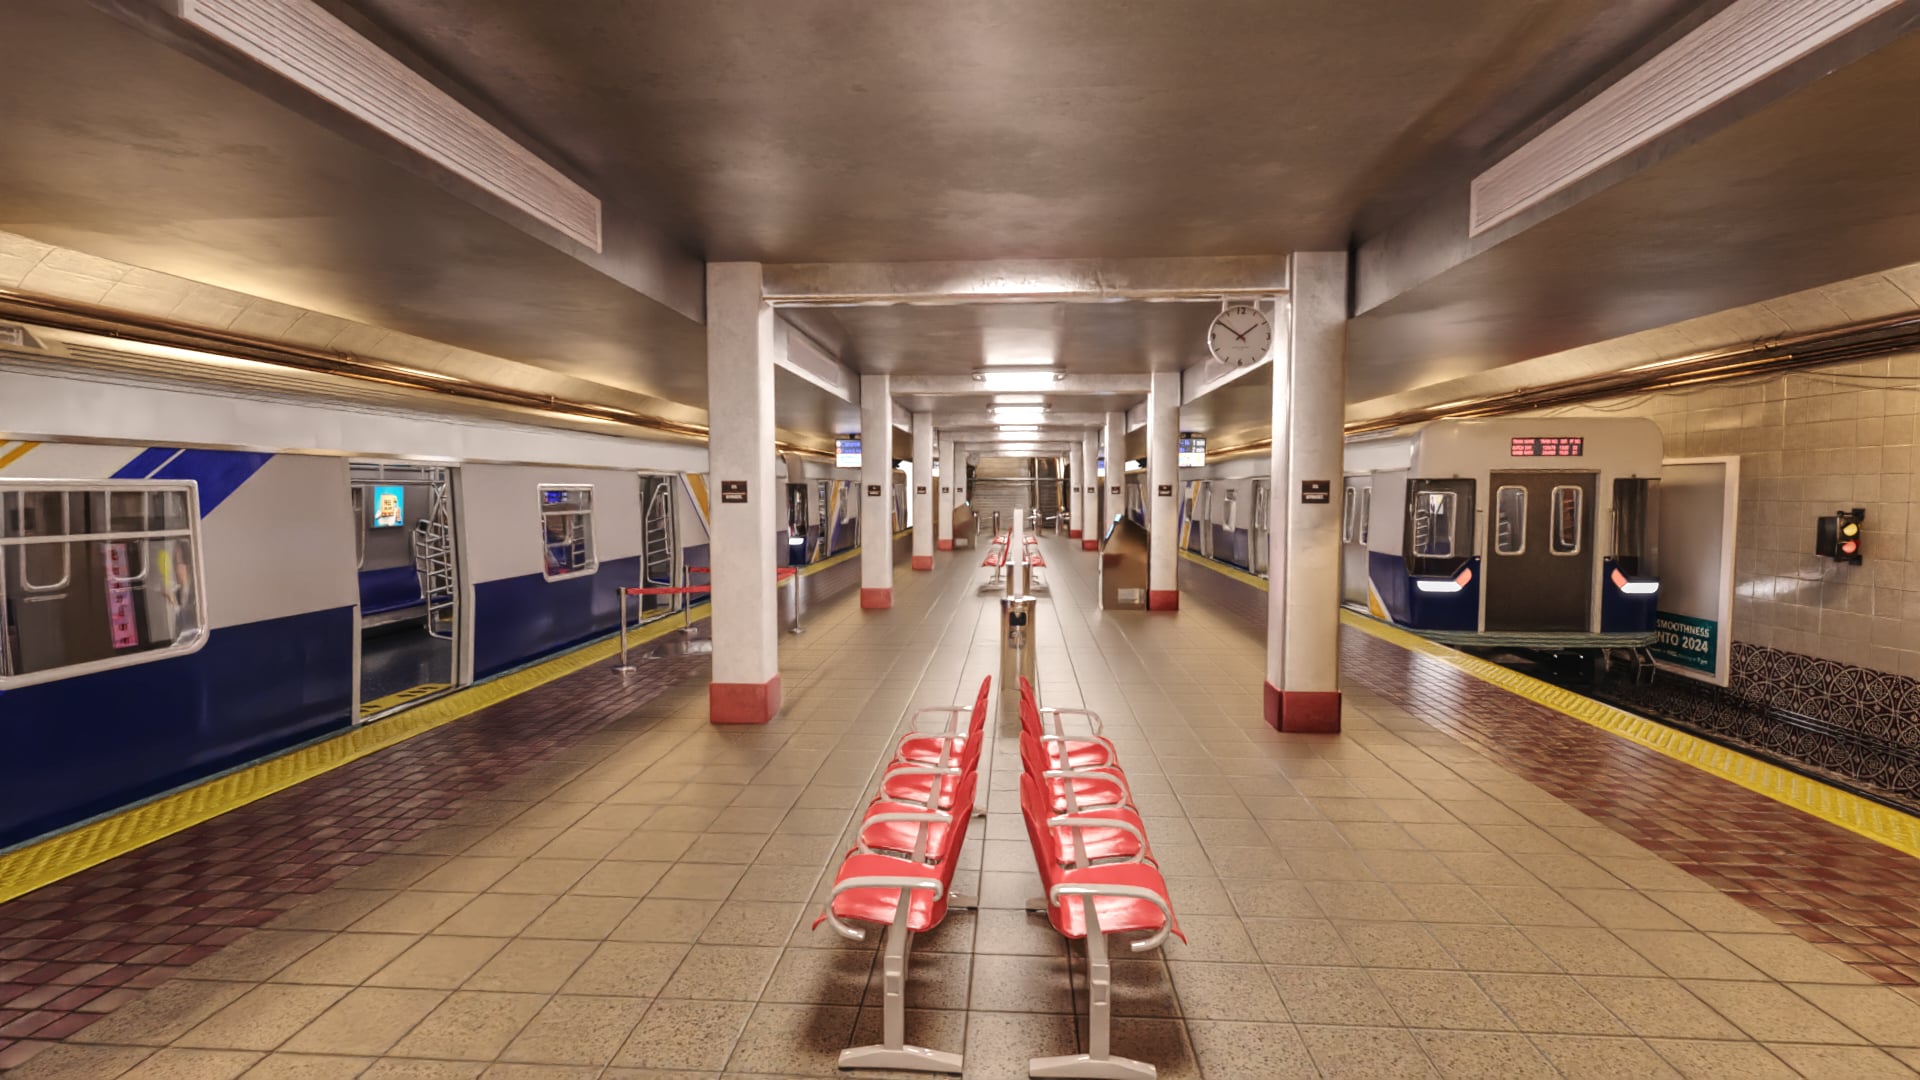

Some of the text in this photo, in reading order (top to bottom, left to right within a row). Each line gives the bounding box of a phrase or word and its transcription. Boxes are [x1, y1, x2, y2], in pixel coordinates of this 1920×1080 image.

[1237, 307, 1246, 315] 12
[1656, 618, 1710, 638] SMOOTHNESS
[1682, 635, 1708, 653] 2024
